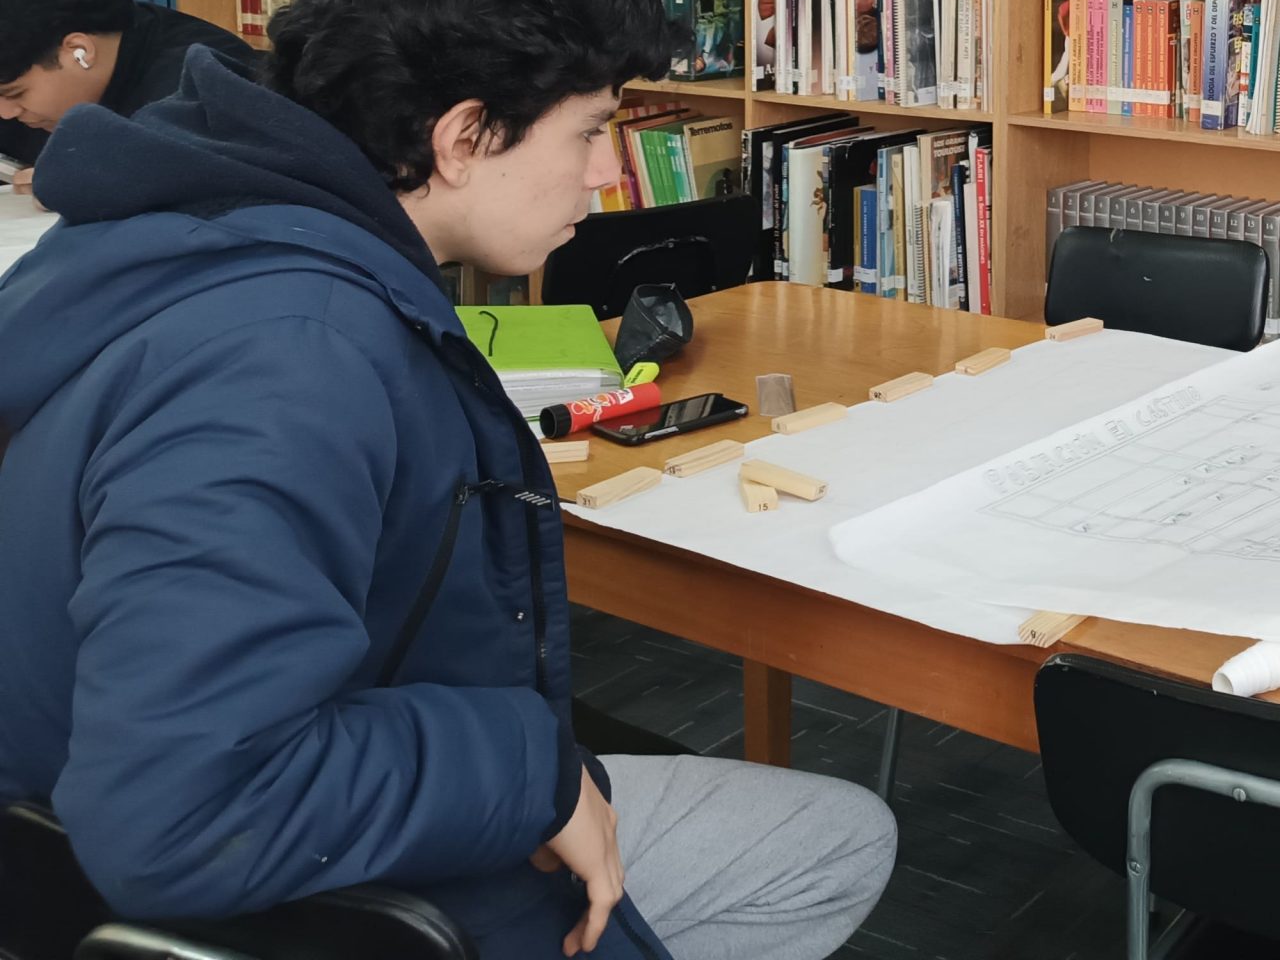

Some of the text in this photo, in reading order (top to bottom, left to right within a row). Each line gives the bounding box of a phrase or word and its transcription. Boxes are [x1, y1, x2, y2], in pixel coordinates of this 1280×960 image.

[1209, 32, 1217, 63] ESFUERZO
[1207, 78, 1215, 100] OLOGIA
[688, 121, 733, 137] Terremotos
[758, 502, 768, 512] 15
